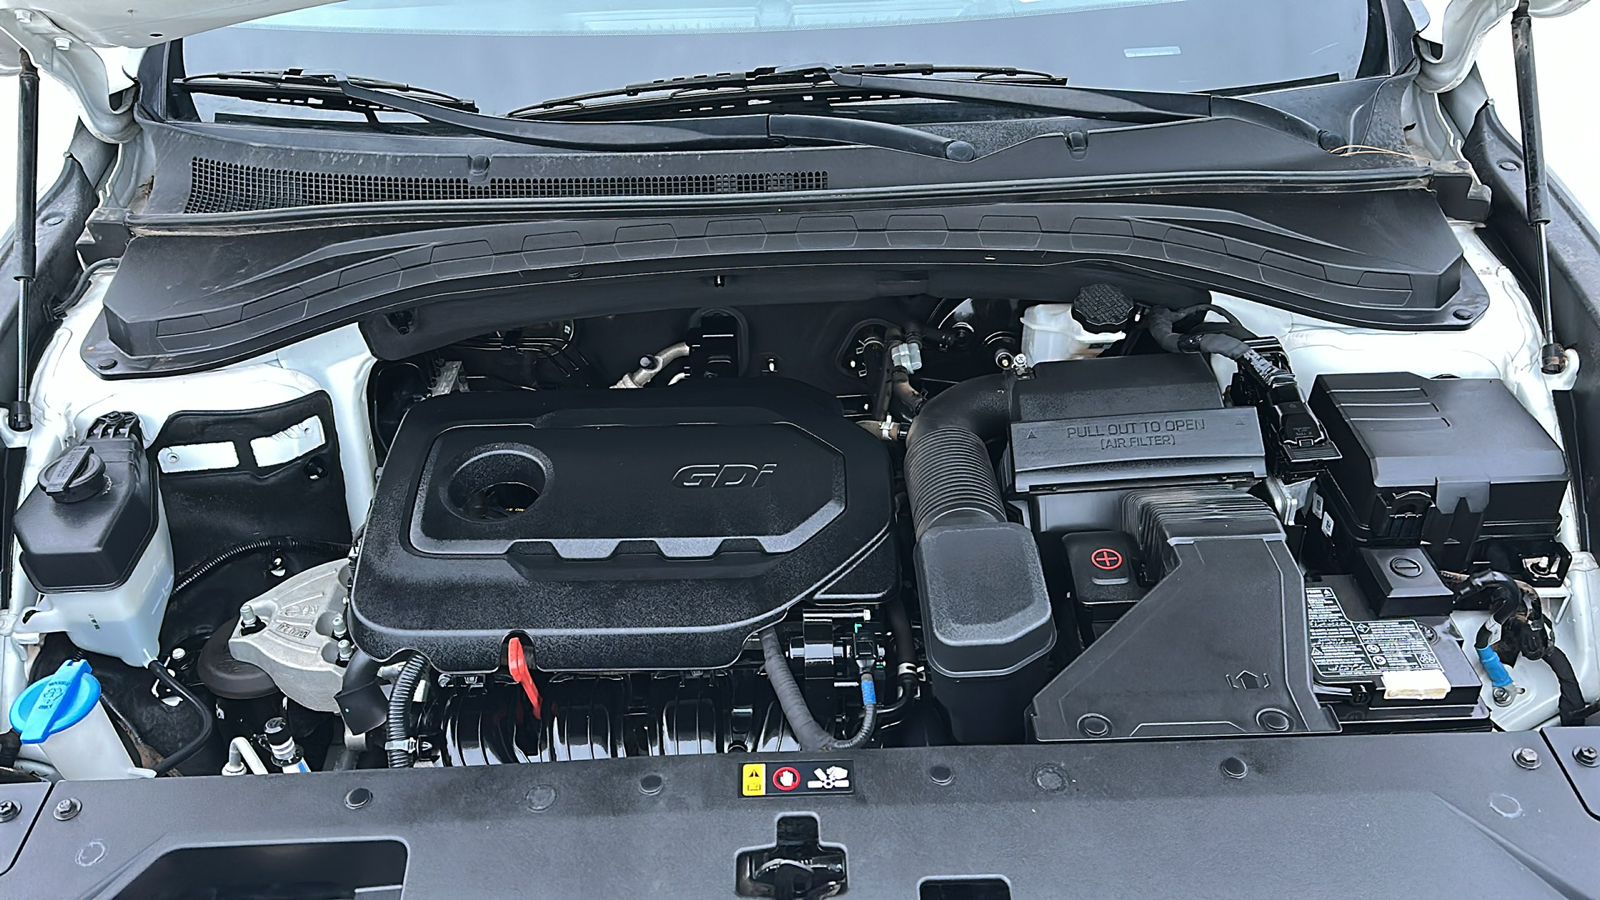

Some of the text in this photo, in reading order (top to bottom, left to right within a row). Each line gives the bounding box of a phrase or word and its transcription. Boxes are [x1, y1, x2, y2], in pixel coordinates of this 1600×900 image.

[1067, 418, 1205, 439] PULL OUT TO OPEN
[671, 463, 778, 489] GDi
